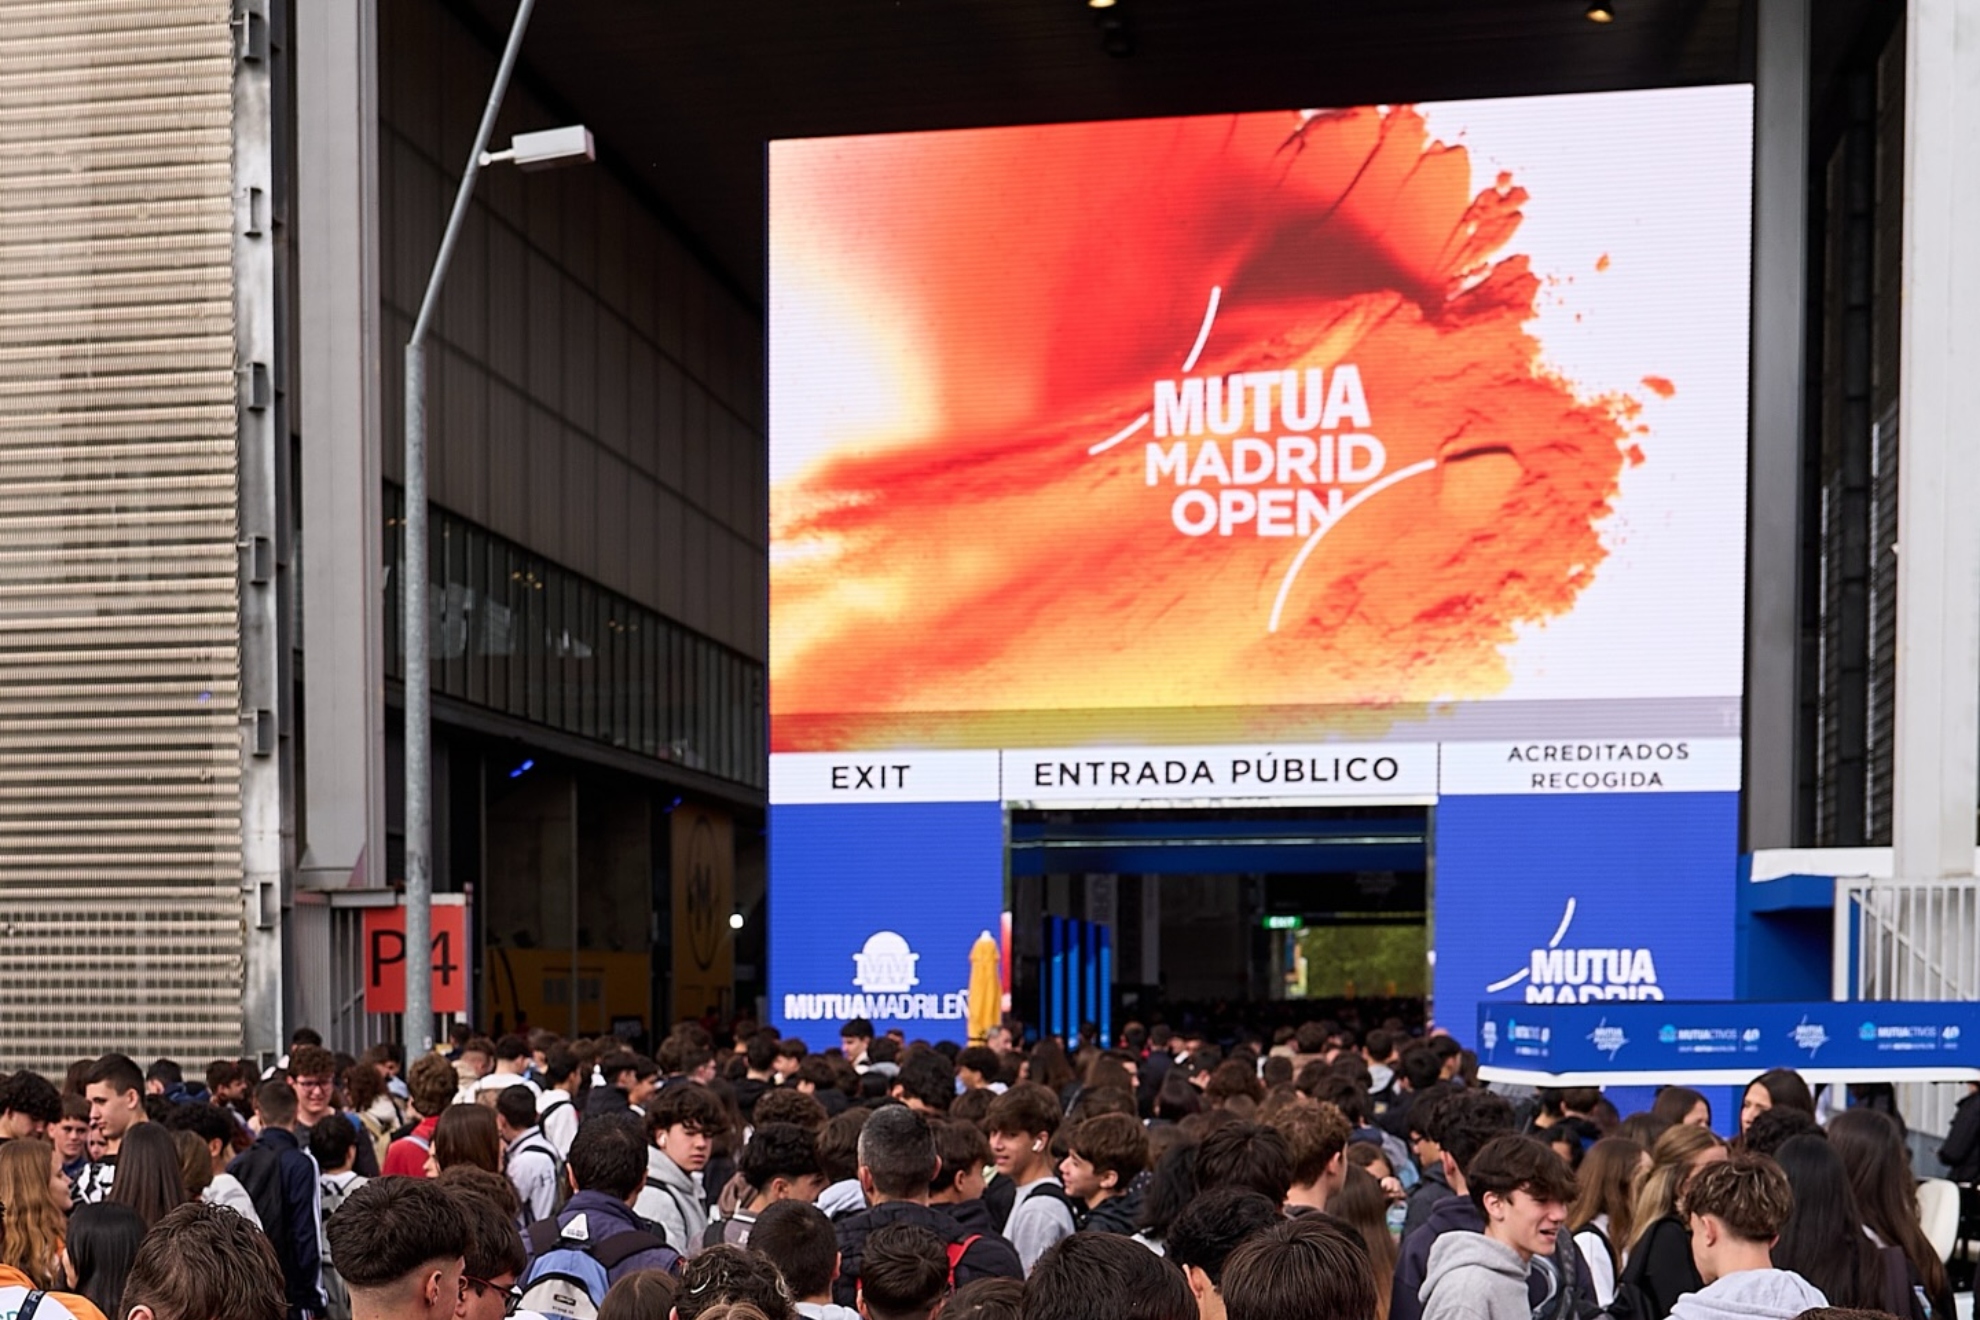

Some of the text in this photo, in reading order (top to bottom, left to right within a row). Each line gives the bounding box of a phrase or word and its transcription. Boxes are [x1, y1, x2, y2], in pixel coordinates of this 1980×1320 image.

[1153, 365, 1371, 437] MUTUA
[1145, 433, 1386, 486] MADRID
[1171, 489, 1343, 536] OPEN
[1035, 752, 1399, 786] ENTRADA PÚBLICO
[1508, 742, 1690, 763] ACREDITADOS
[831, 765, 911, 790] EXIT
[1532, 771, 1664, 790] RECOGIDA
[1531, 949, 1657, 985] MUTUA
[785, 989, 970, 1020] MUTUAMADRILEÑ
